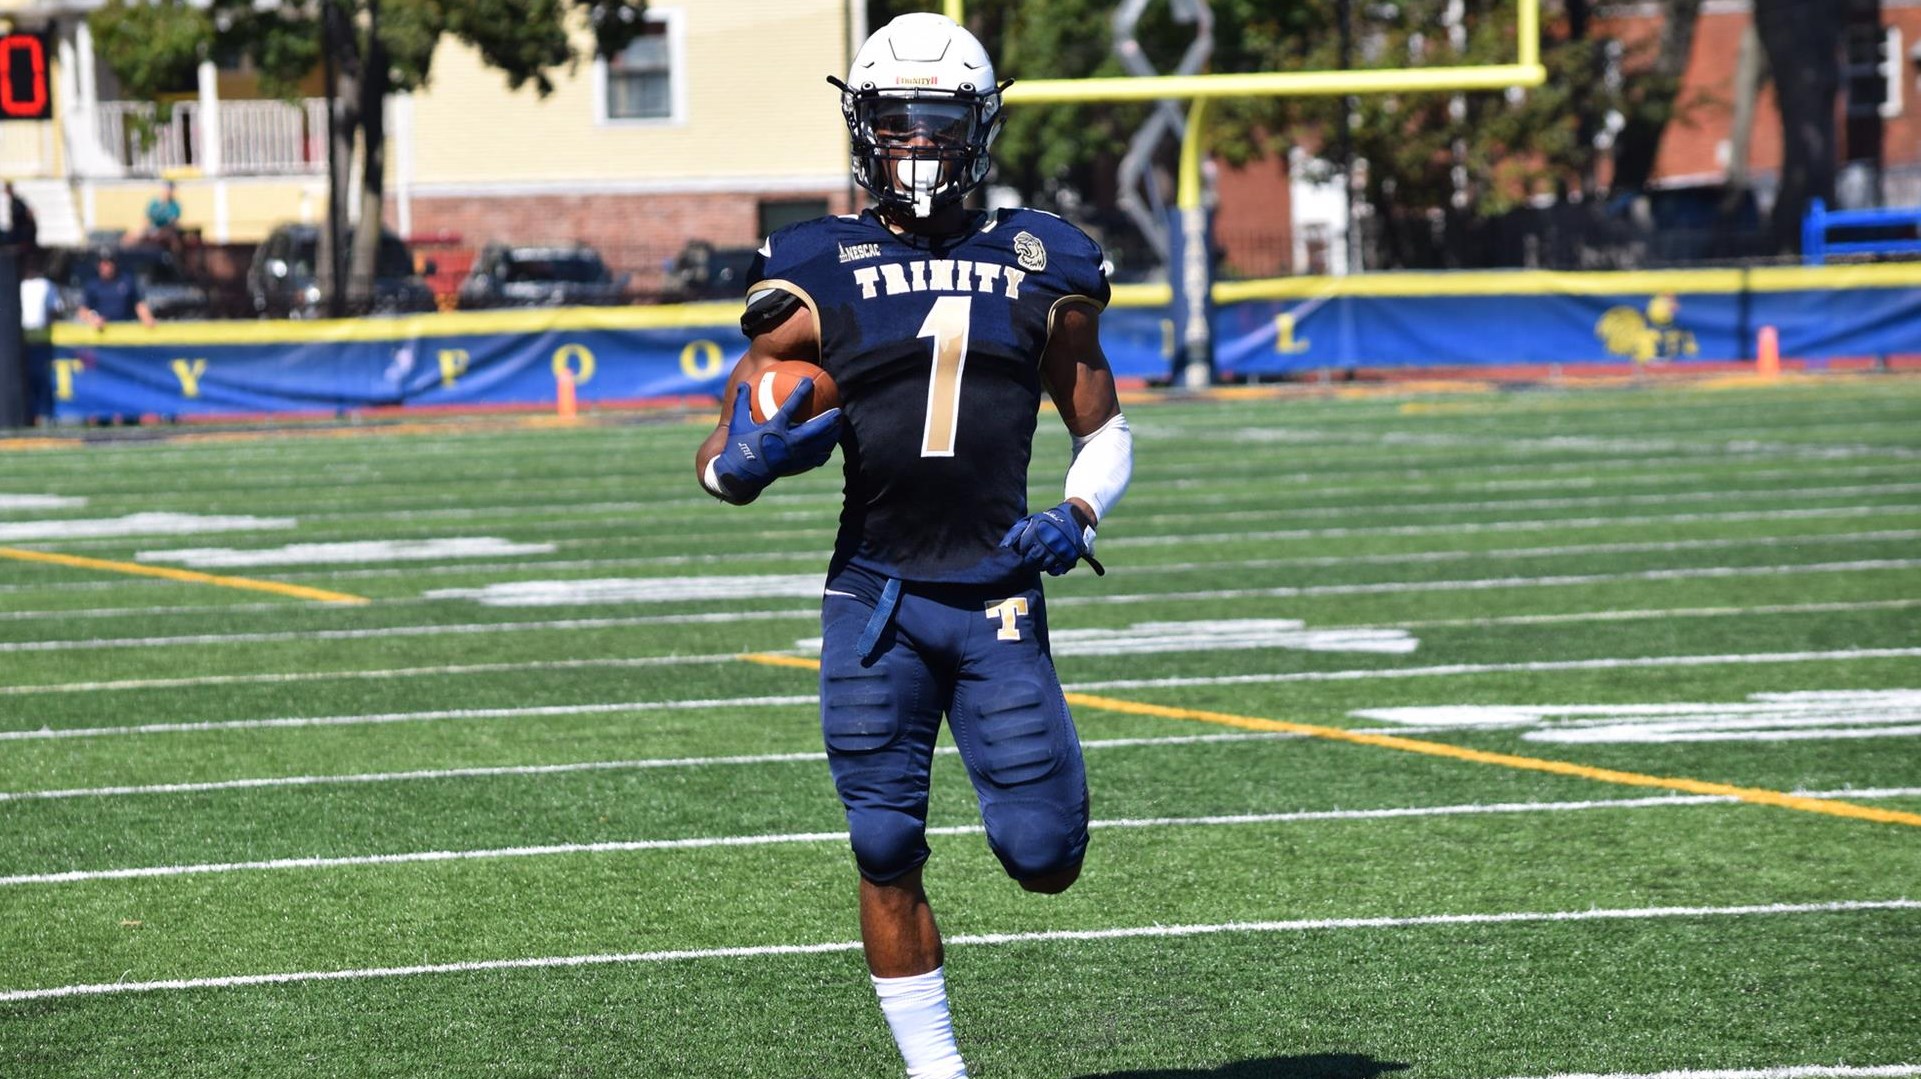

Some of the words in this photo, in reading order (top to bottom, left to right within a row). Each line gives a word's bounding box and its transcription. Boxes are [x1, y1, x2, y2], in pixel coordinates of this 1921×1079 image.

[0, 34, 47, 116] 0
[845, 243, 882, 261] NESCAC
[853, 259, 1026, 299] TRINITY
[916, 296, 973, 458] 1
[984, 597, 1029, 641] T
